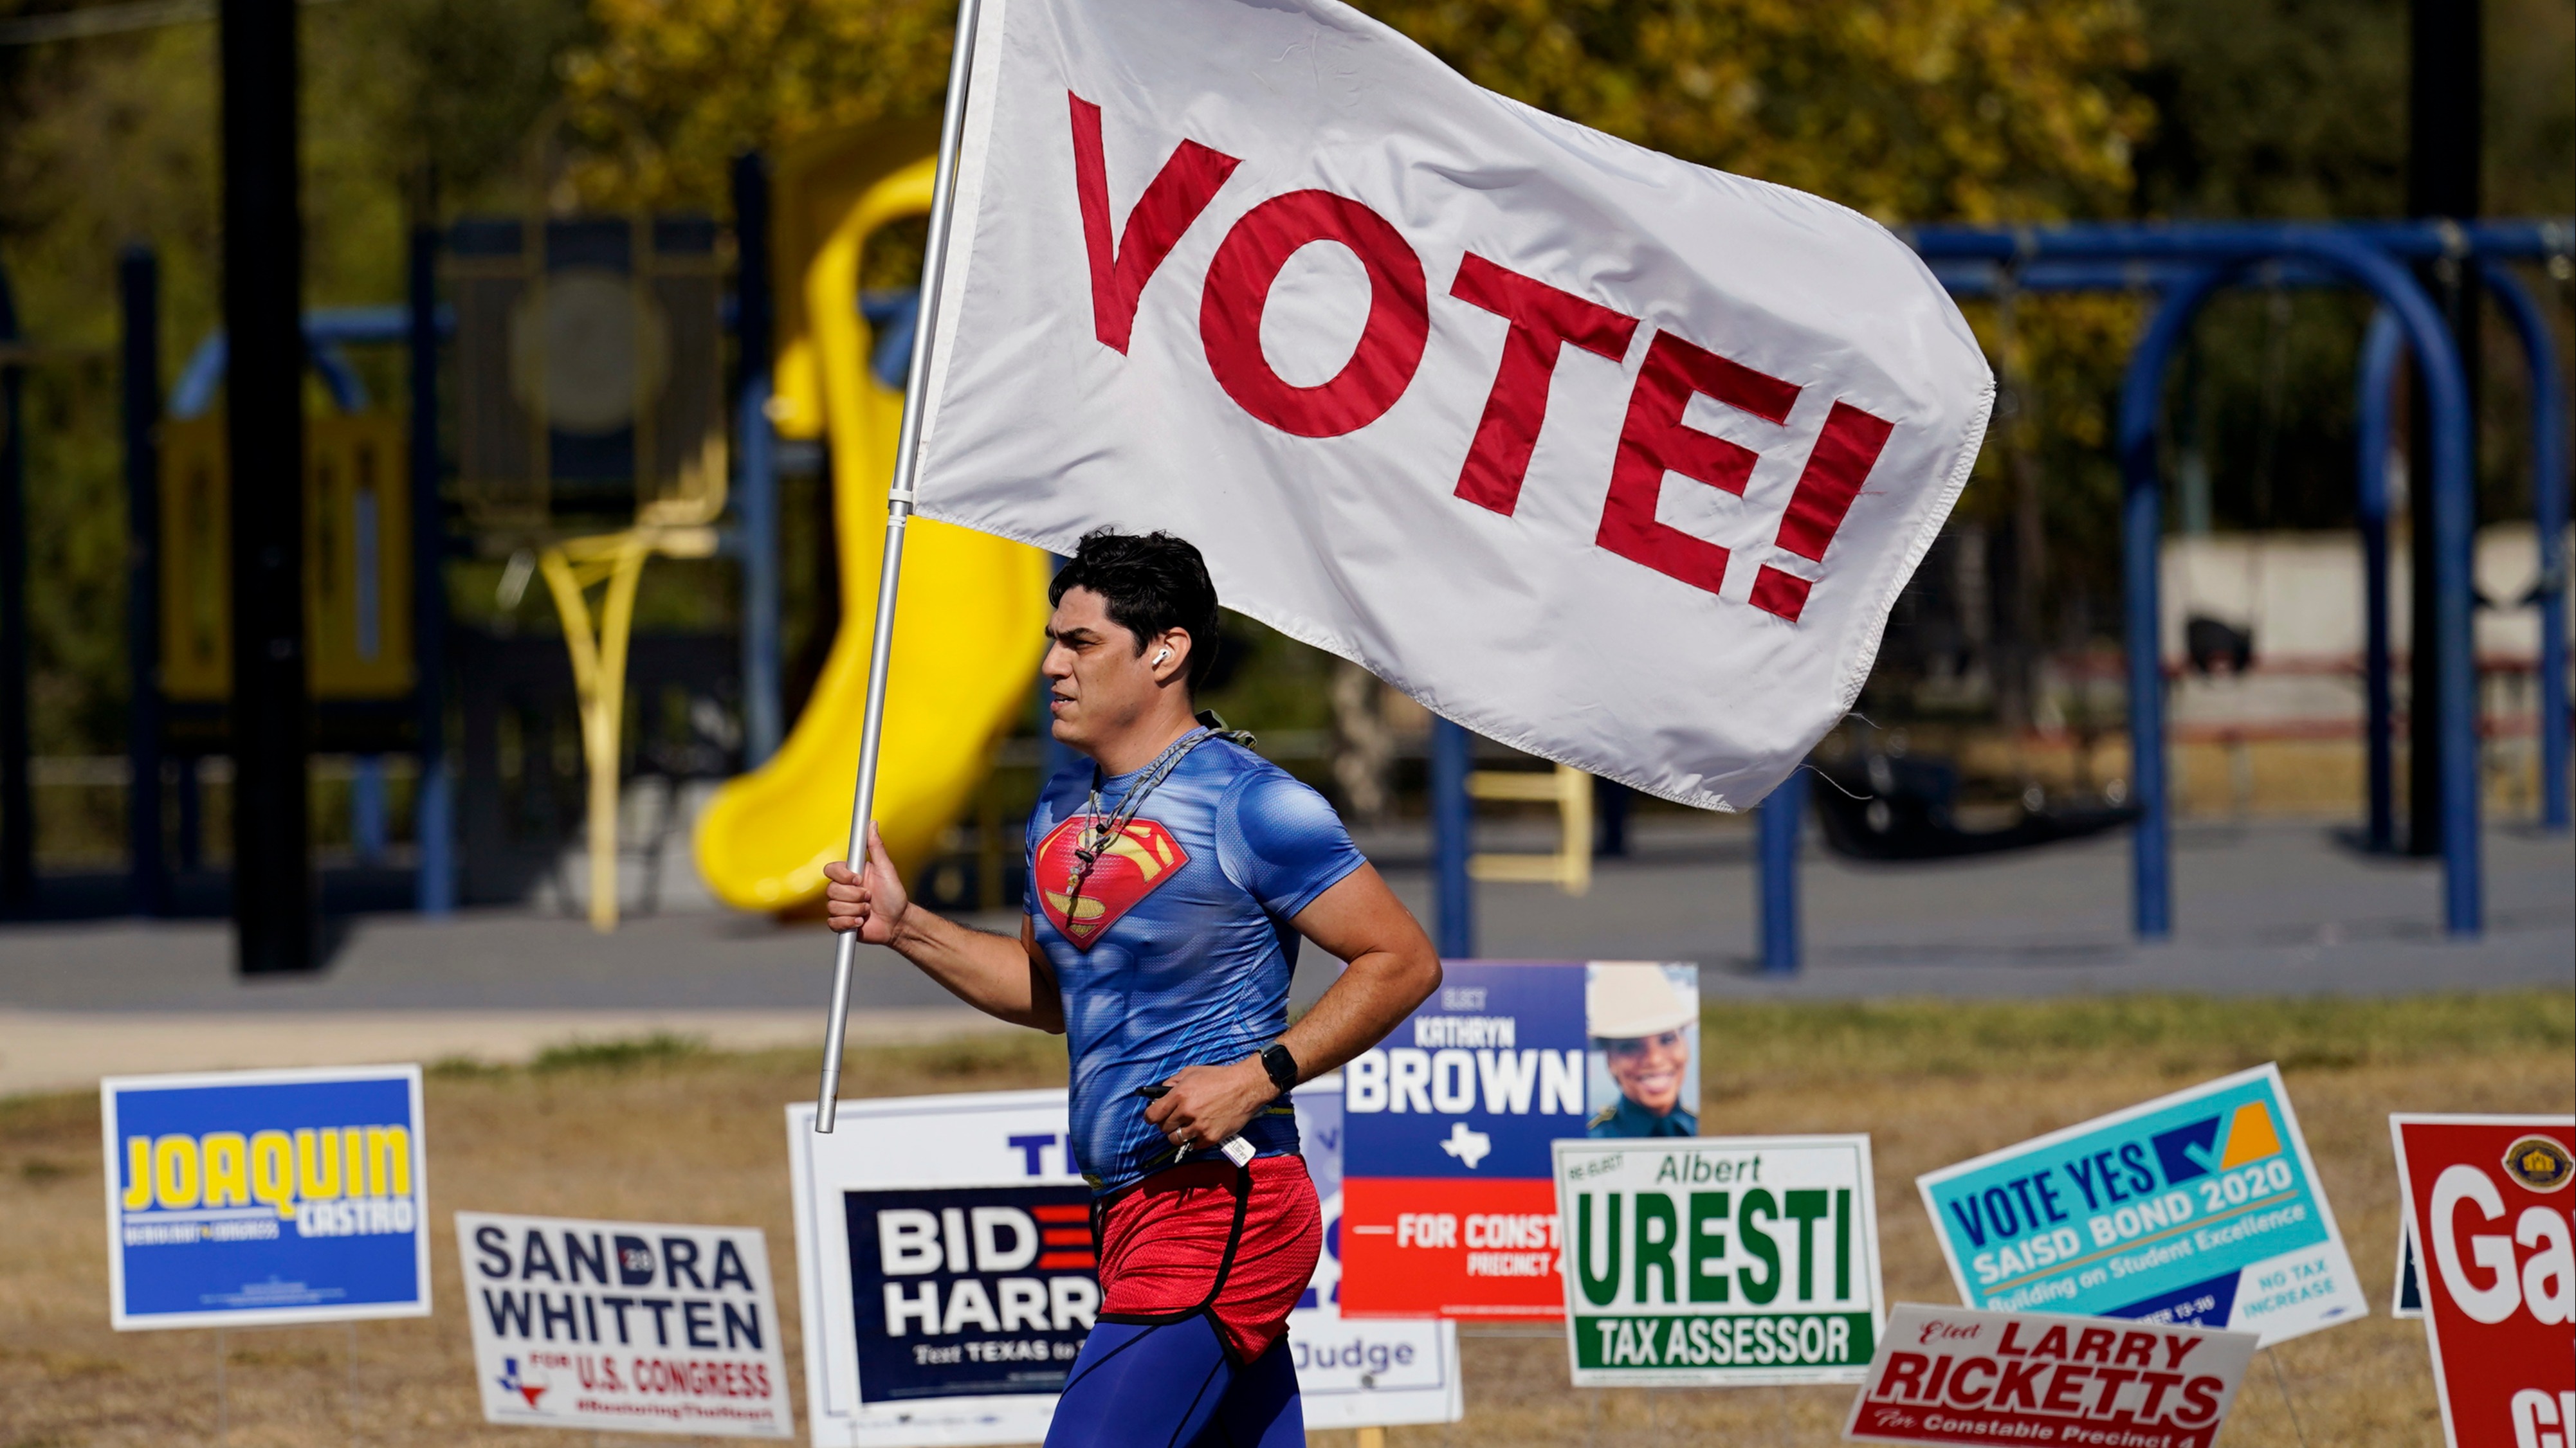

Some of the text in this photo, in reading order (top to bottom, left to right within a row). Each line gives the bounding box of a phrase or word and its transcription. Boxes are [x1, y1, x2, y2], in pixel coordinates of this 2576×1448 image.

[1068, 89, 1895, 623] VOTE!
[1442, 987, 1486, 1011] ELECT
[1415, 1016, 1515, 1047] KATHRYN
[1347, 1047, 1584, 1116] BROWN
[123, 1125, 411, 1218] JOAQUIN
[1656, 1152, 1764, 1183] Albert
[297, 1200, 416, 1238] CASTRO
[1950, 1142, 2155, 1249] VOTE YES
[1397, 1213, 1457, 1249] FOR
[1973, 1158, 2292, 1285] SAISD BOND 2020
[476, 1226, 754, 1292] SANDRA
[1466, 1252, 1552, 1276] PRECINCT
[1577, 1188, 1851, 1306] URESTI
[1987, 1204, 2306, 1313] Building on Student Excellence
[2243, 1276, 2337, 1319] INCREASE
[2258, 1258, 2328, 1291] NO TAX
[484, 1289, 763, 1349] WHITTEN
[1597, 1316, 1850, 1365] TAX ASSESSOR
[913, 1344, 963, 1365] Text
[965, 1340, 1049, 1362] TEXAS
[1052, 1342, 1075, 1360] to
[1295, 1340, 1414, 1373] Judge
[1919, 1320, 2204, 1370] Elect LARRY
[577, 1350, 627, 1391] U.S.
[632, 1352, 772, 1398] CONGRESS
[1869, 1350, 2225, 1430] RICKETTS
[1874, 1408, 1918, 1429] For
[1923, 1413, 2054, 1440] Constable
[2060, 1424, 2173, 1448] Precinct
